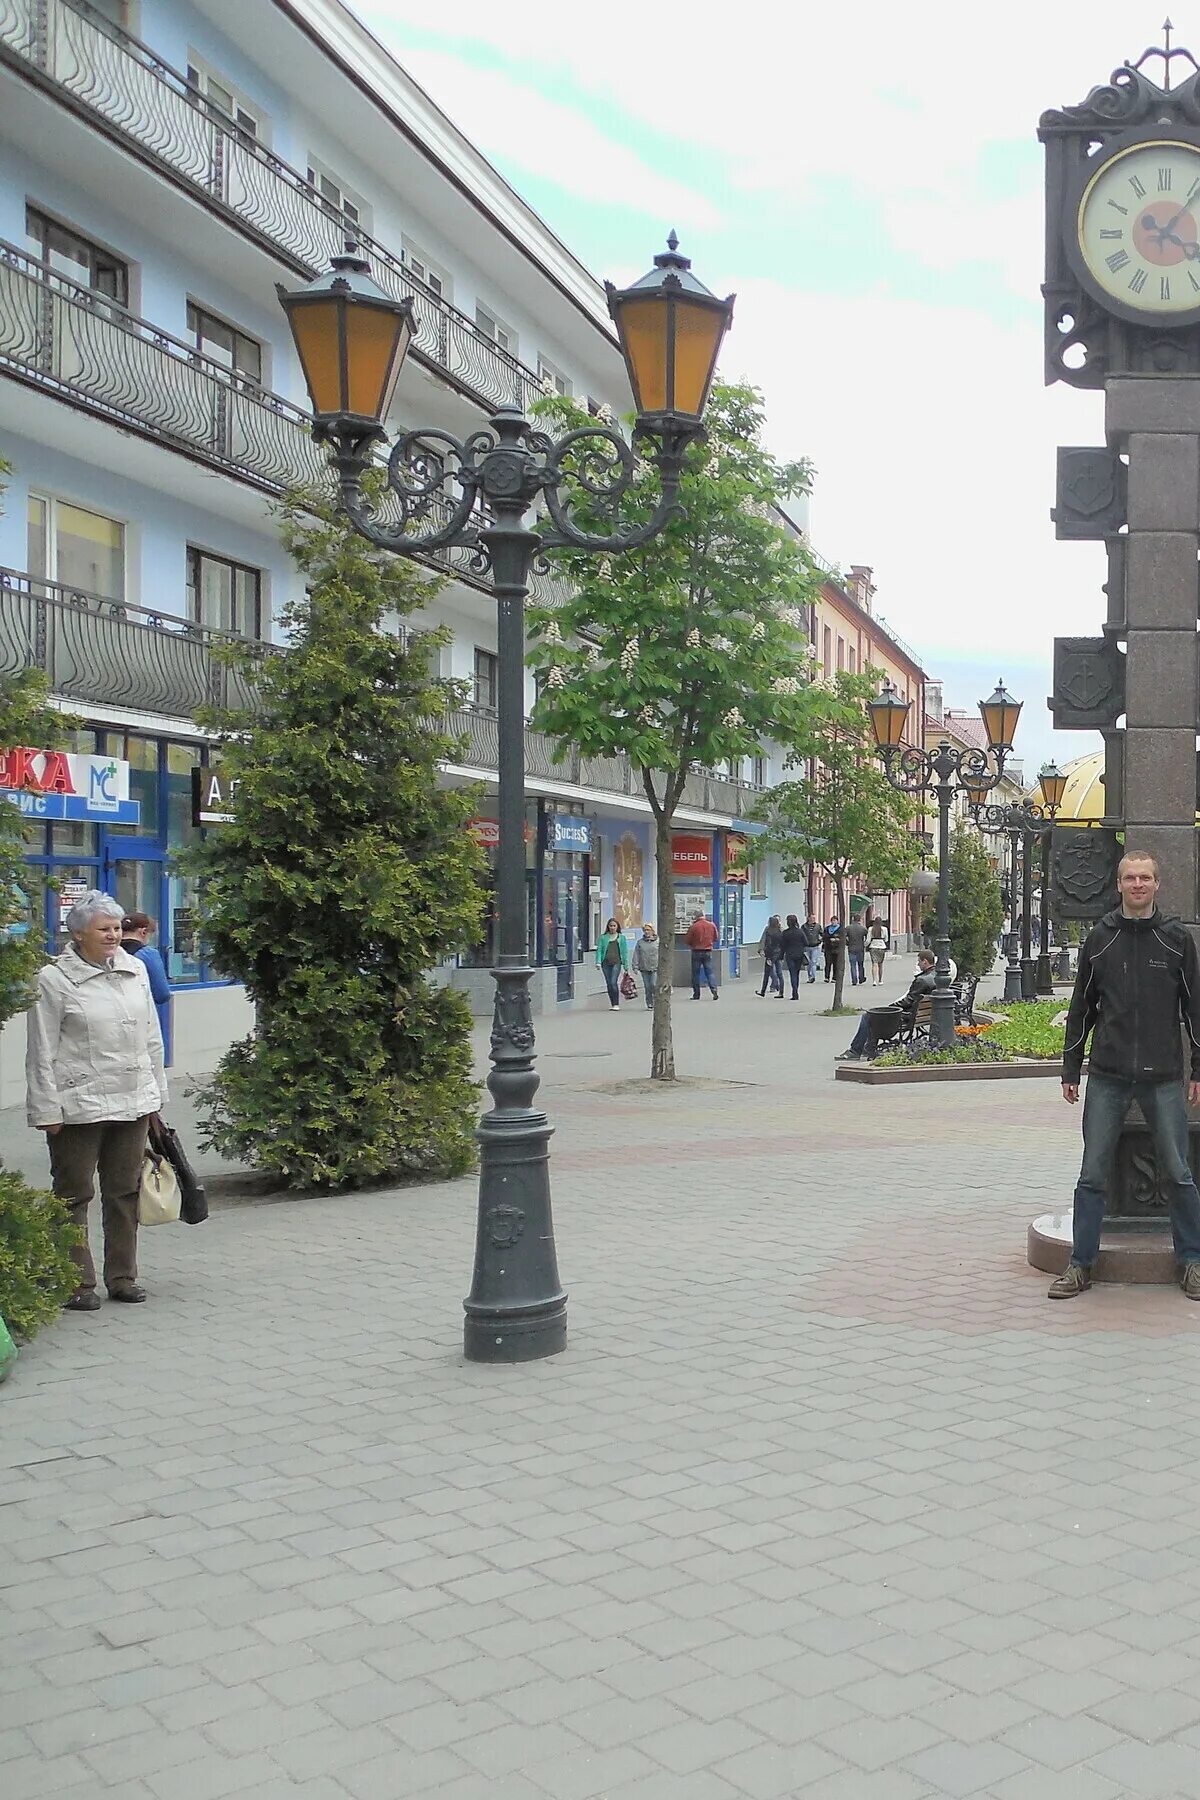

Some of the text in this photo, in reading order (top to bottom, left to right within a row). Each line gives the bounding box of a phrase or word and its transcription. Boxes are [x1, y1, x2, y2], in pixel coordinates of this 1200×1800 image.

[1128, 175, 1147, 200] XI
[1157, 168, 1172, 192] XII
[1107, 198, 1128, 216] X
[1187, 270, 1200, 292] V
[672, 852, 708, 861] ЕБЕЛЬ
